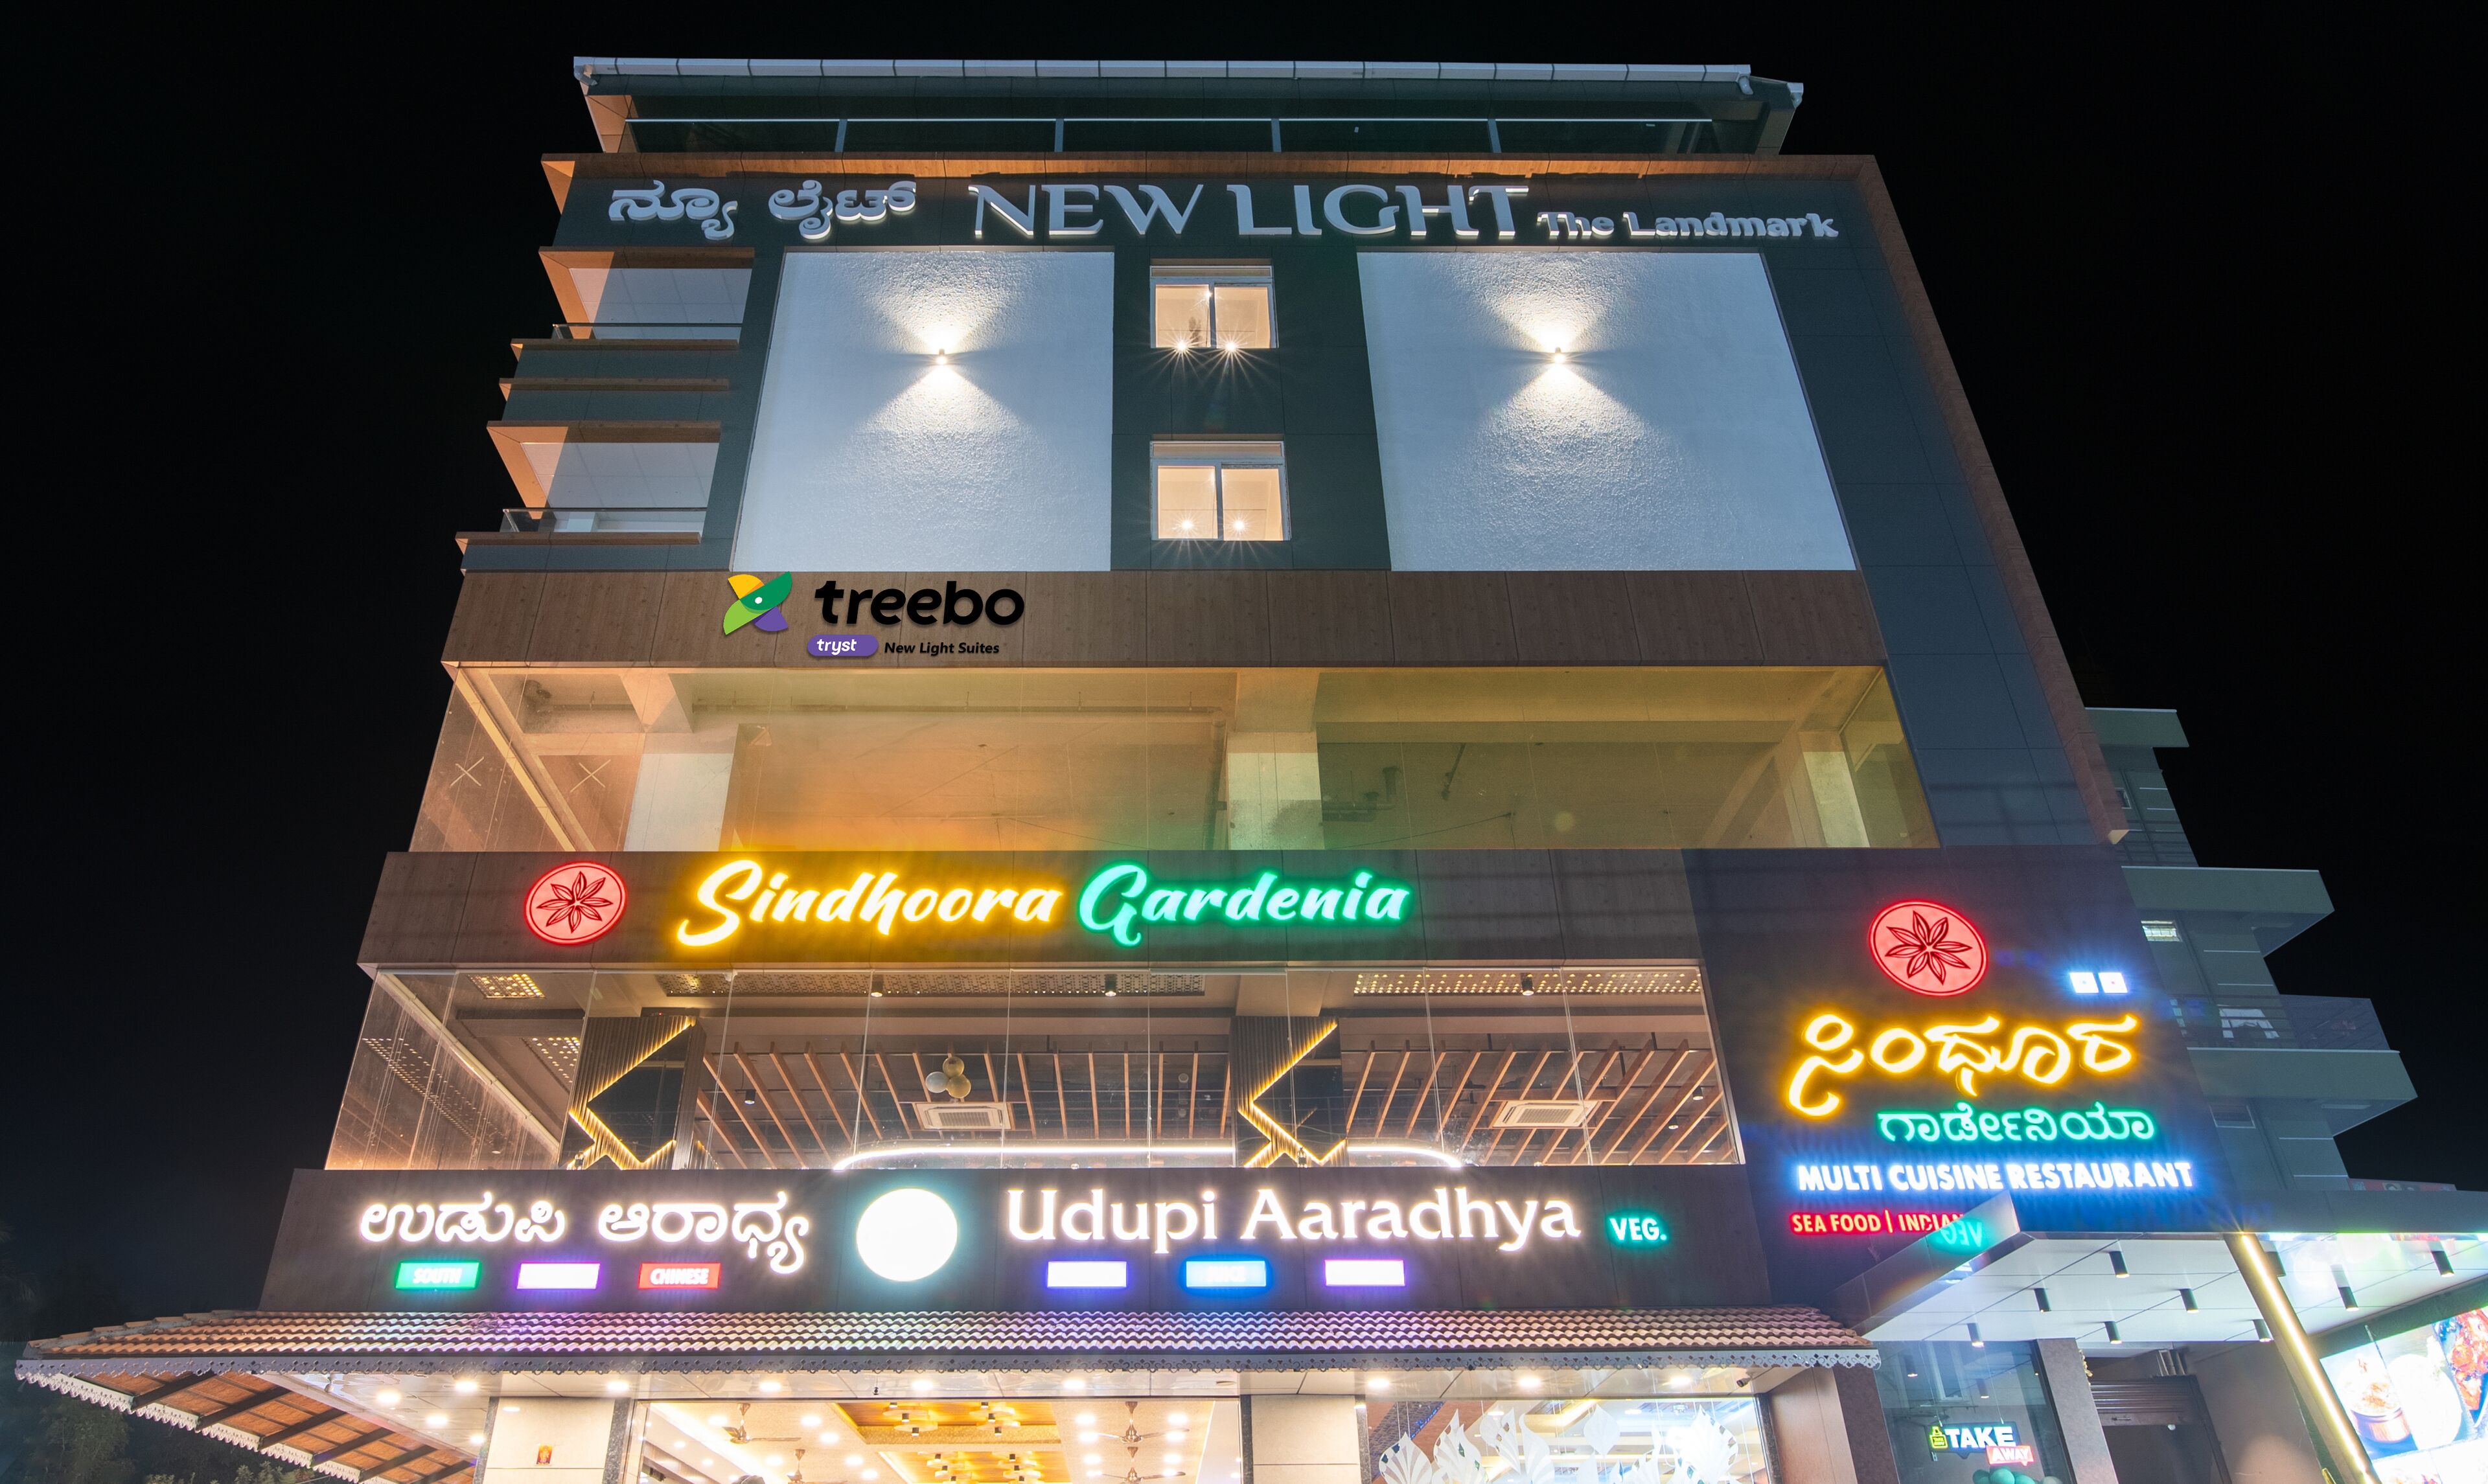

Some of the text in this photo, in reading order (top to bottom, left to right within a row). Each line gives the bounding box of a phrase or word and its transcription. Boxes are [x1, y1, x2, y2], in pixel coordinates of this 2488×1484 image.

[608, 179, 917, 240] ನ್ಯೂ ಲೈಟ್
[968, 184, 1529, 239] NEW LIGHT
[1537, 212, 1839, 239] The Landmark
[814, 580, 1024, 625] treebo
[816, 639, 857, 656] tryst
[884, 641, 1000, 656] New Light Suites
[676, 859, 1410, 947] Sindhoora Gardenia
[1798, 1162, 2193, 1191] MULTI CUISINE RESTAURANT
[360, 1191, 809, 1274] ಉಡುಪಿ ಆರಾಧ್ಯ
[1008, 1187, 1582, 1254] Udupi Aaradhya
[1609, 1218, 1666, 1240] VEG.
[1792, 1215, 1826, 1232] SEA
[1830, 1214, 1881, 1232] FOOD
[650, 1268, 710, 1285] CHINESE
[1945, 1426, 2016, 1448] TAKE
[1992, 1448, 2029, 1462] AWAY
